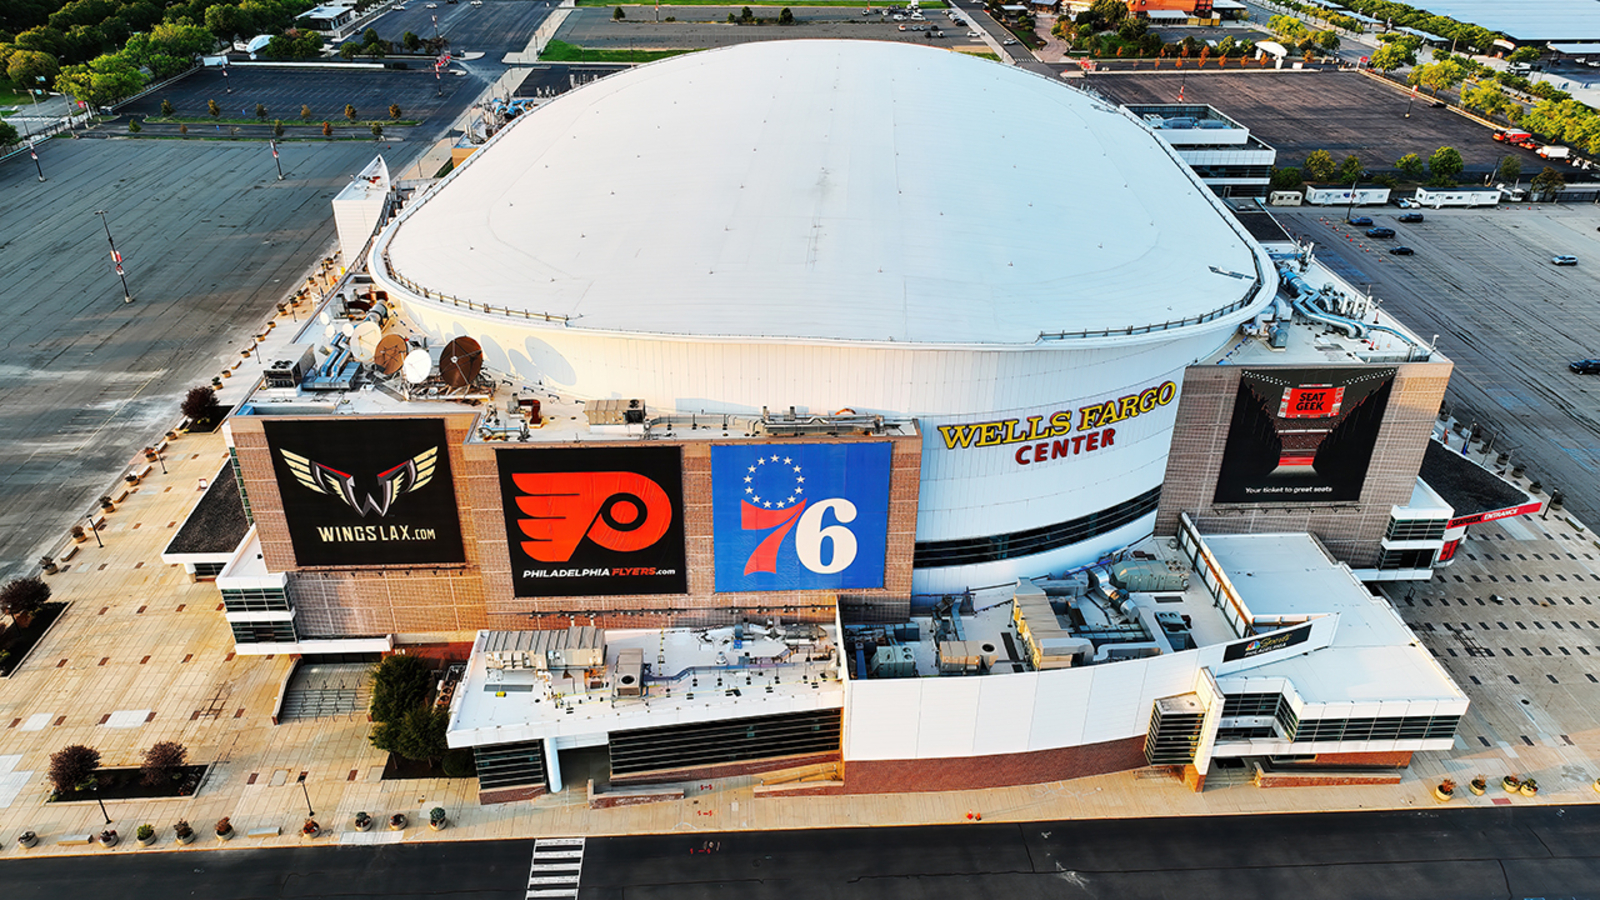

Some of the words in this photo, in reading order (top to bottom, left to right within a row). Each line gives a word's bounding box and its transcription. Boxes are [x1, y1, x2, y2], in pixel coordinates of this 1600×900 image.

[1299, 392, 1326, 402] SEAT
[1296, 401, 1325, 411] GEEK
[937, 411, 1072, 450] WELLS
[1077, 380, 1177, 431] FARGO
[1015, 428, 1116, 465] CENTER
[1245, 486, 1262, 494] Your
[1263, 486, 1284, 494] ticket
[1284, 486, 1293, 494] to
[1293, 486, 1313, 494] great
[1484, 508, 1519, 521] ENTRANCE
[741, 497, 858, 577] 76
[522, 568, 611, 579] PHILADELPHIA
